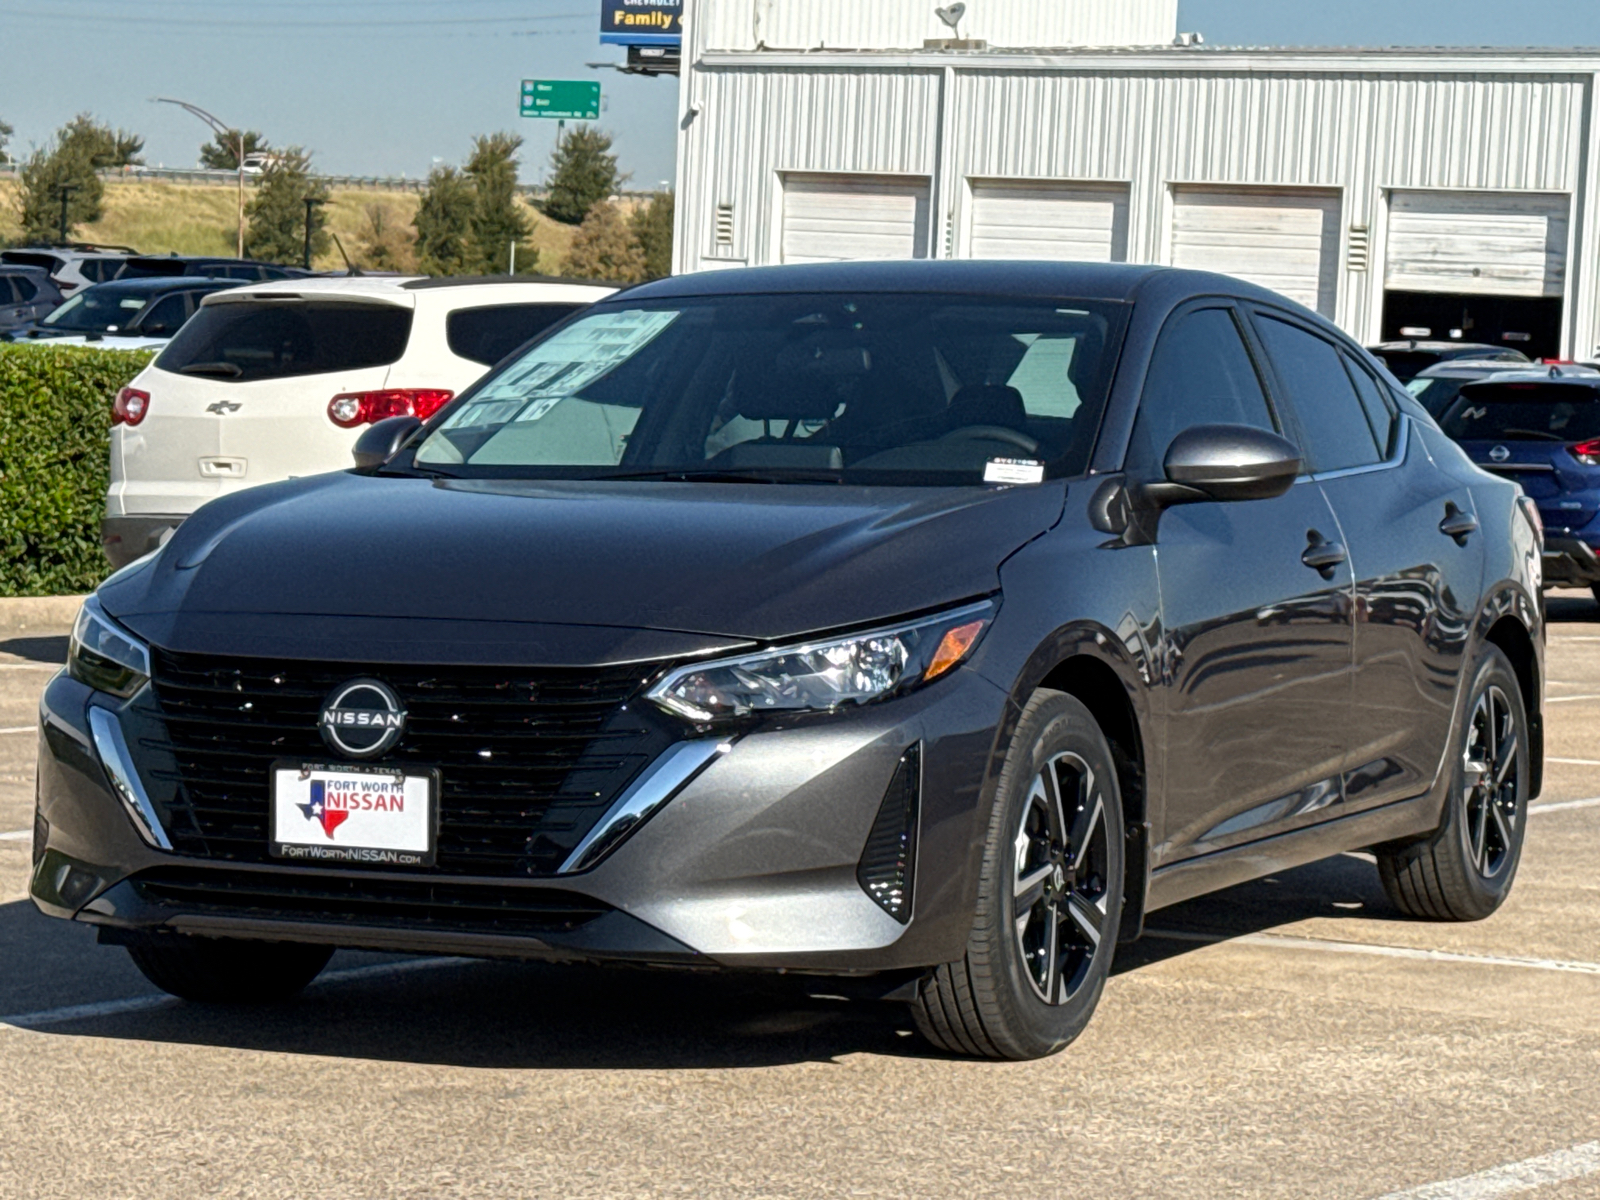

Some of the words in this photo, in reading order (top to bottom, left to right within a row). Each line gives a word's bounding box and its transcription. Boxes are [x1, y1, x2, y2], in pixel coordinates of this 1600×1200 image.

[614, 10, 673, 29] Family
[323, 710, 401, 727] NISSAN
[327, 780, 358, 791] FORT
[361, 781, 404, 794] WORTH
[327, 792, 404, 812] NISSAN
